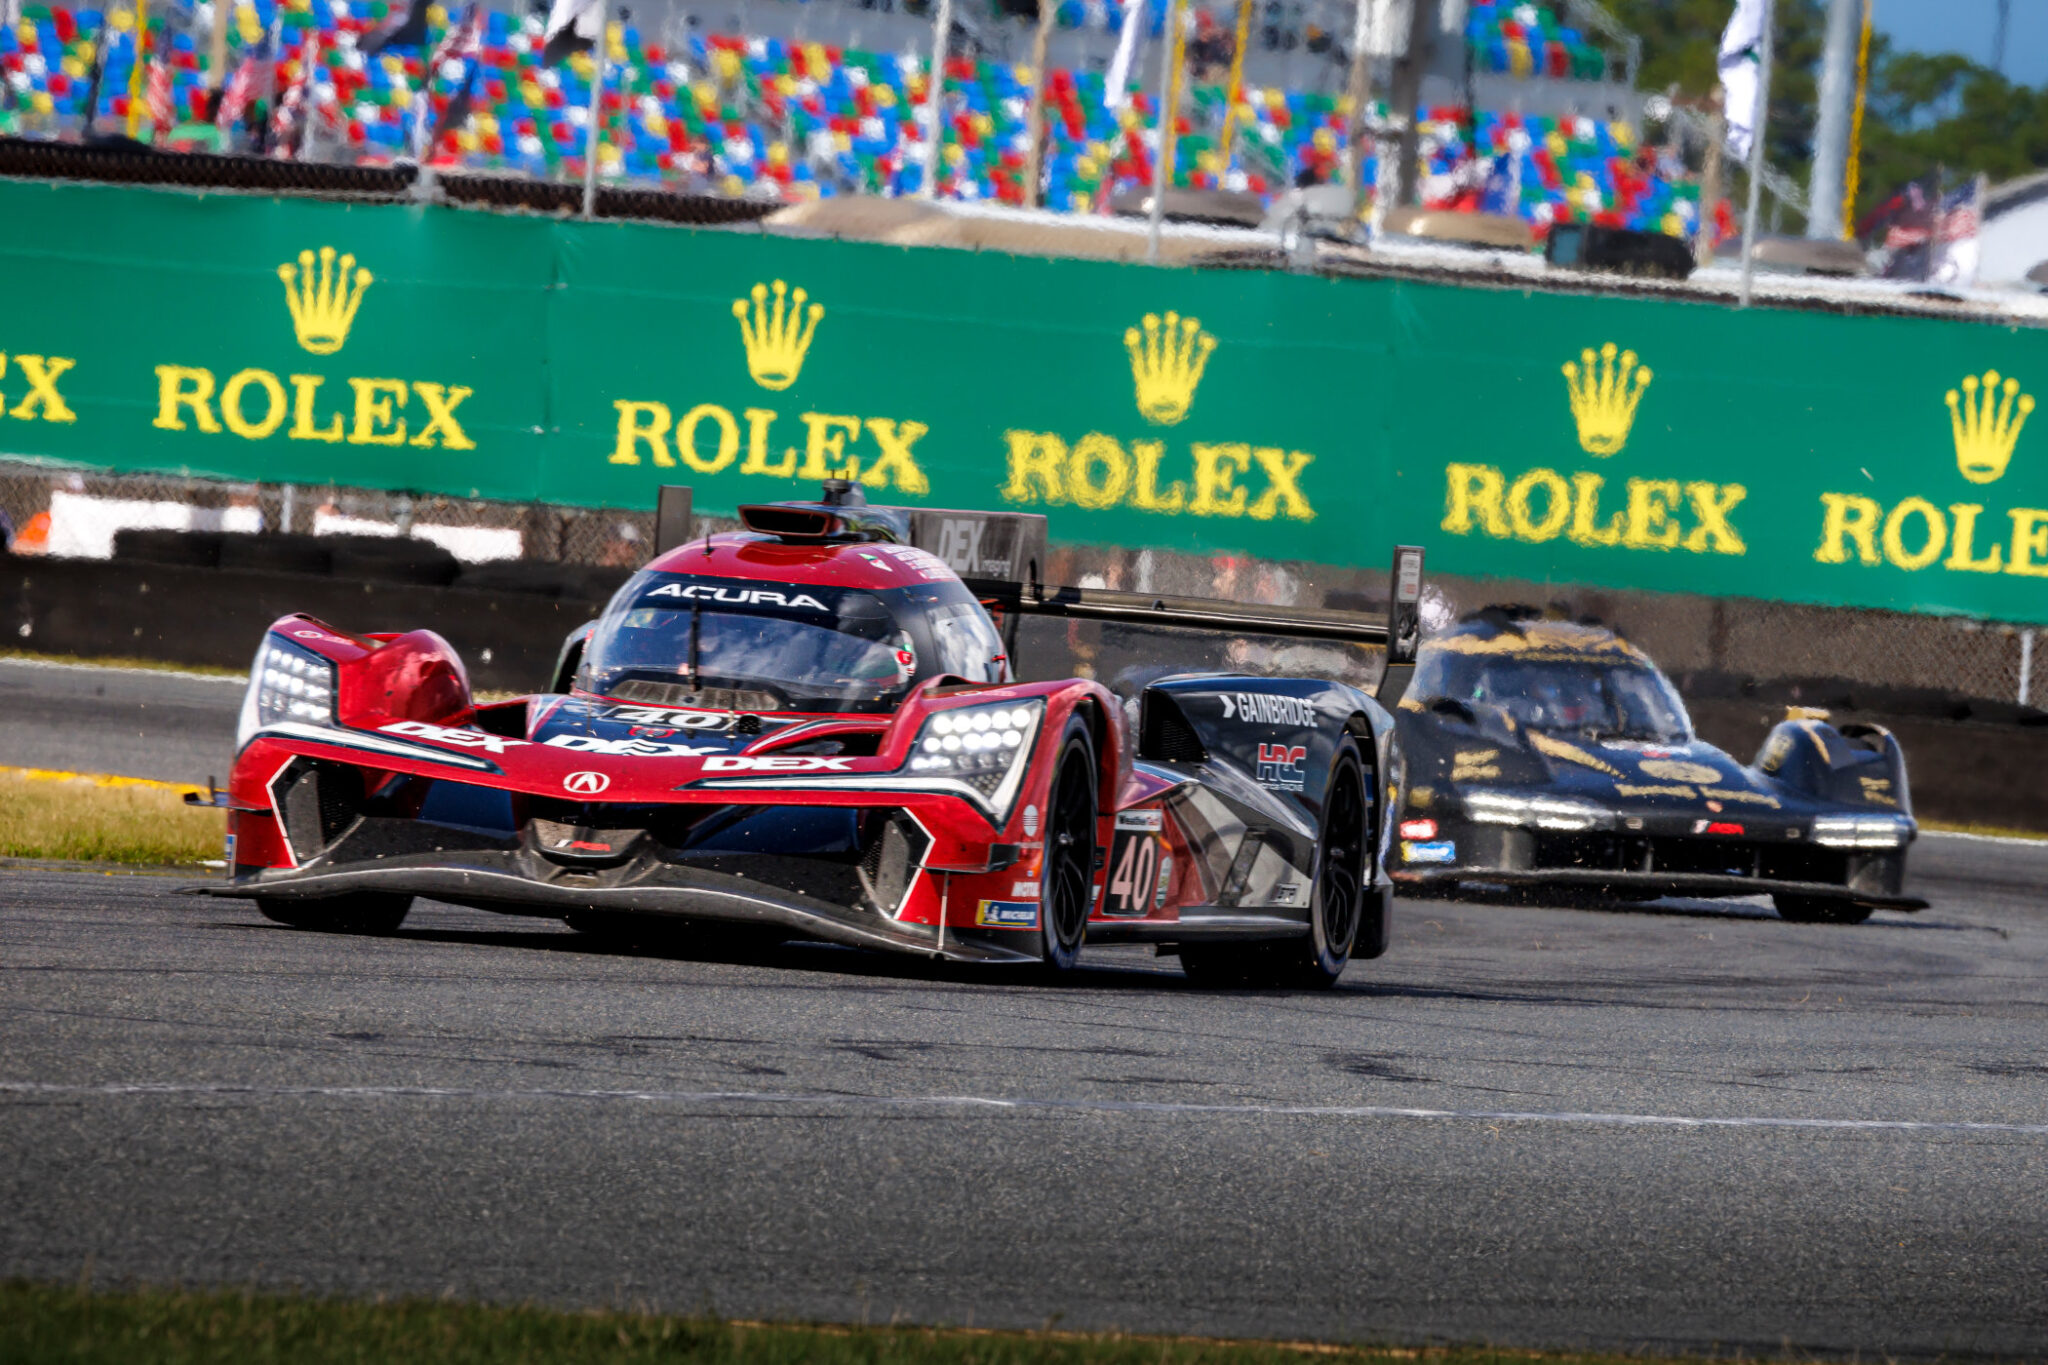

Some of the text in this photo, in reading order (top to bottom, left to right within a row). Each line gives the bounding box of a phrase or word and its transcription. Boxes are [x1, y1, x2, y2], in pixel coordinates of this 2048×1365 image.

[0, 352, 77, 422] X
[152, 364, 476, 450] ROLEX
[609, 399, 930, 495] ROLEX
[1000, 428, 1317, 521] ROLEX
[1440, 462, 1747, 555] ROLEX
[1813, 491, 2048, 577] ROLE
[938, 518, 987, 572] DEX
[646, 583, 830, 611] ACURA
[379, 720, 533, 753] DEX
[615, 708, 725, 728] 40
[1236, 692, 1318, 728] GAINBRIDGE
[542, 733, 729, 757] DEX
[701, 756, 856, 771] DEX
[1256, 742, 1307, 783] HRC
[1109, 835, 1155, 911] 40
